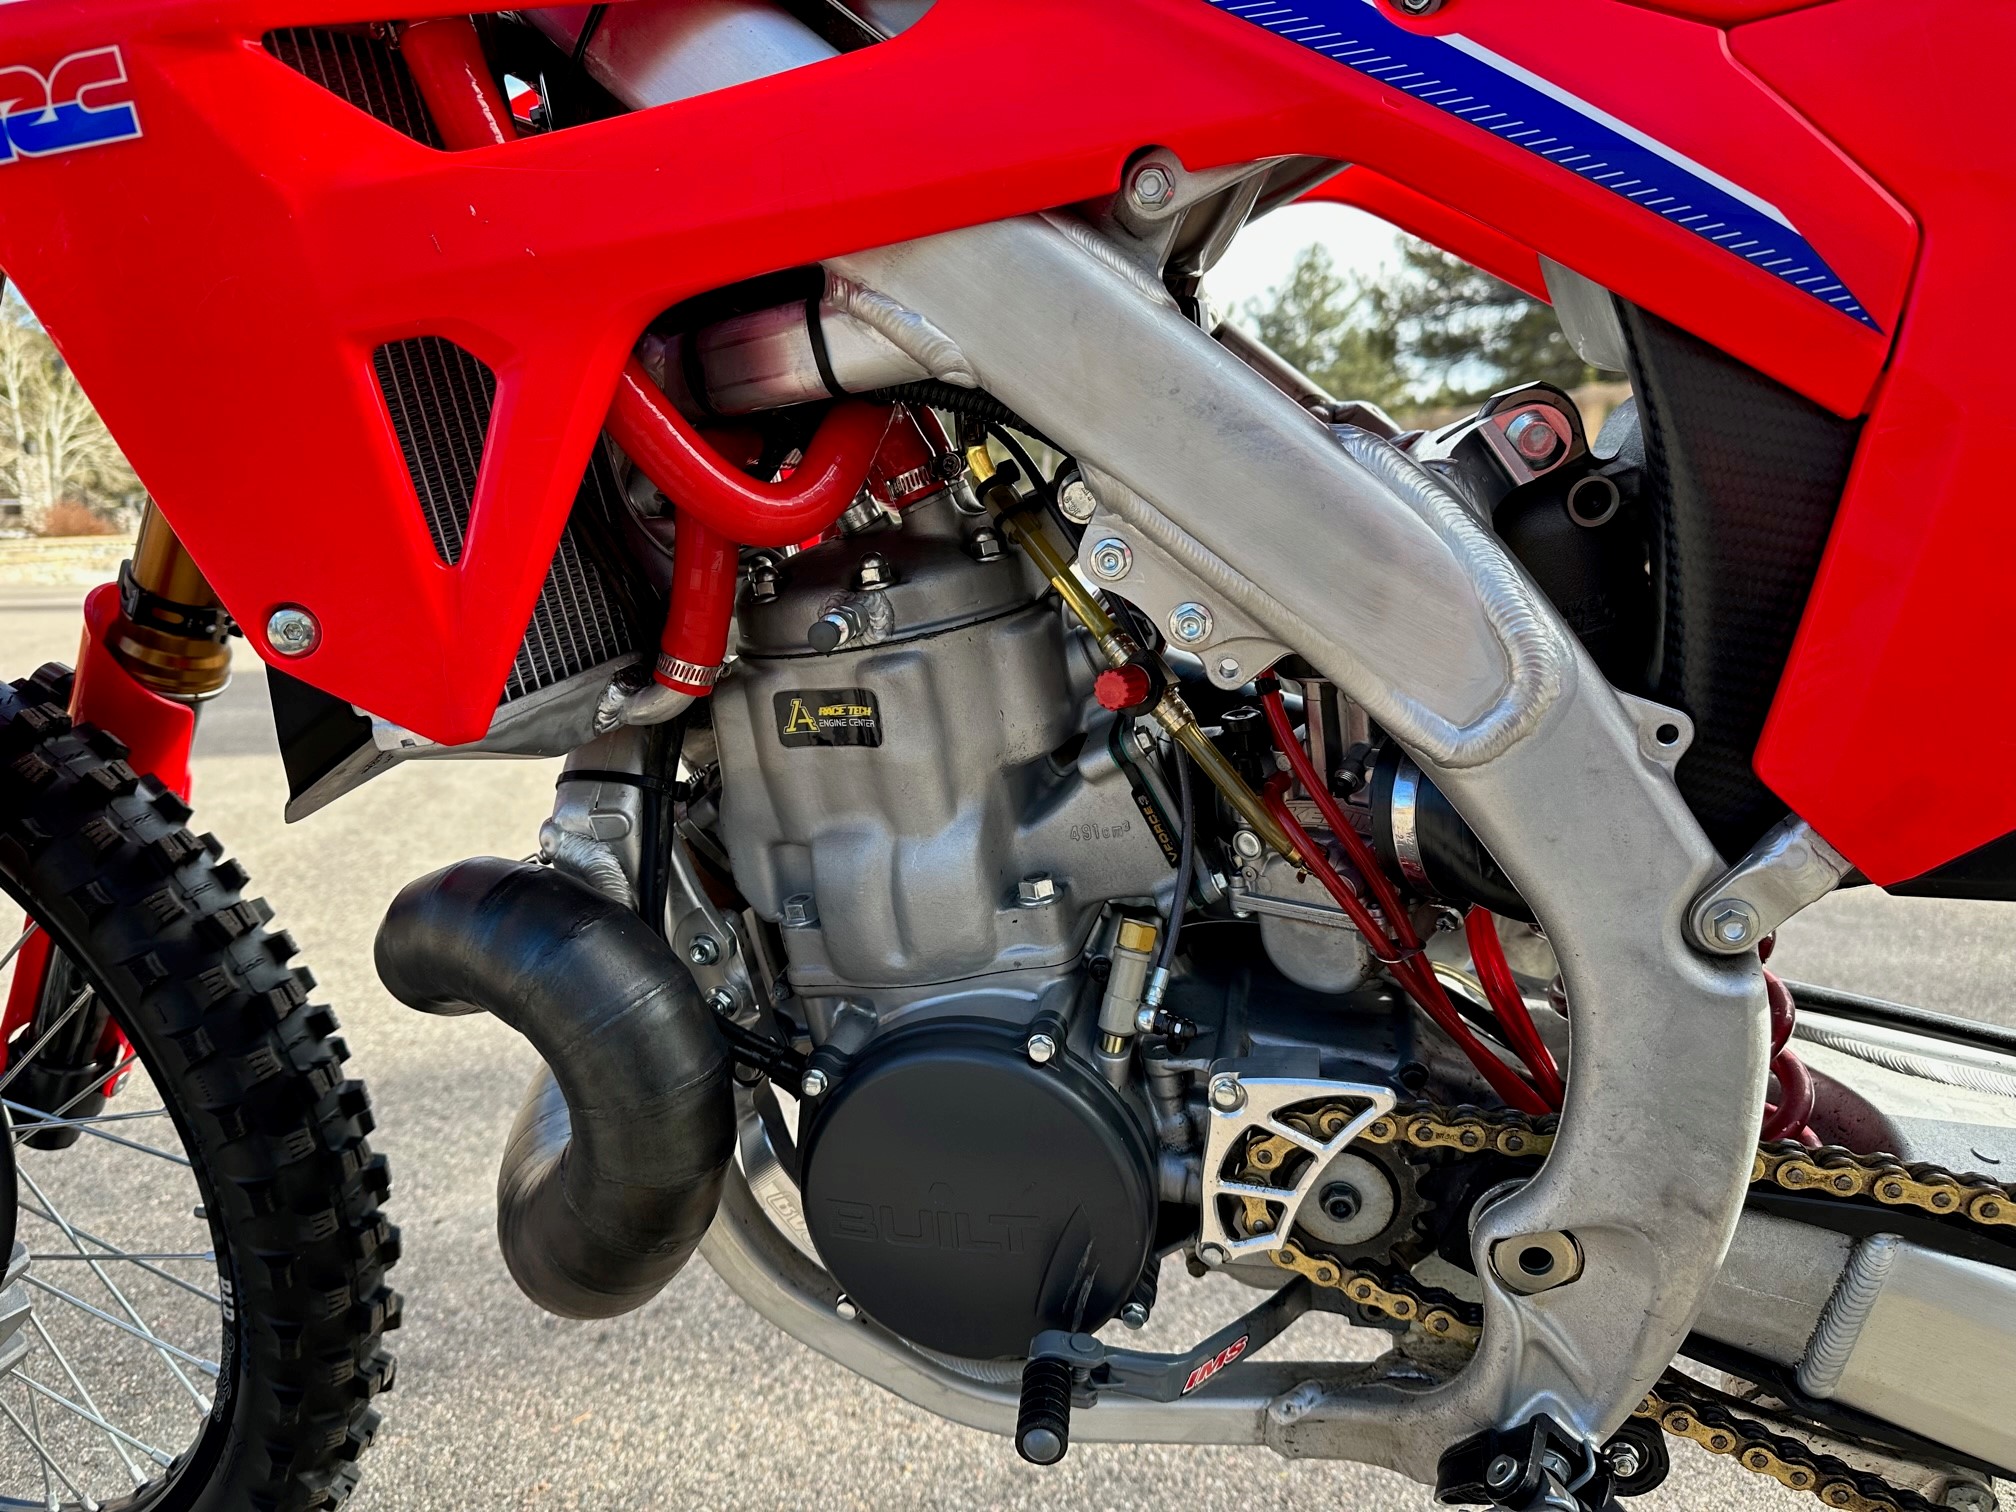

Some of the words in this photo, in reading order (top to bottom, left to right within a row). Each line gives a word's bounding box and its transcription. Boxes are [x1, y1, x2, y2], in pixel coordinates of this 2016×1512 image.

[818, 705, 846, 716] RACE
[847, 705, 873, 716] TECH
[819, 718, 847, 727] ENGINE
[848, 718, 875, 728] CENTER
[826, 1198, 1041, 1254] BUILT
[1181, 1335, 1249, 1394] IMS
